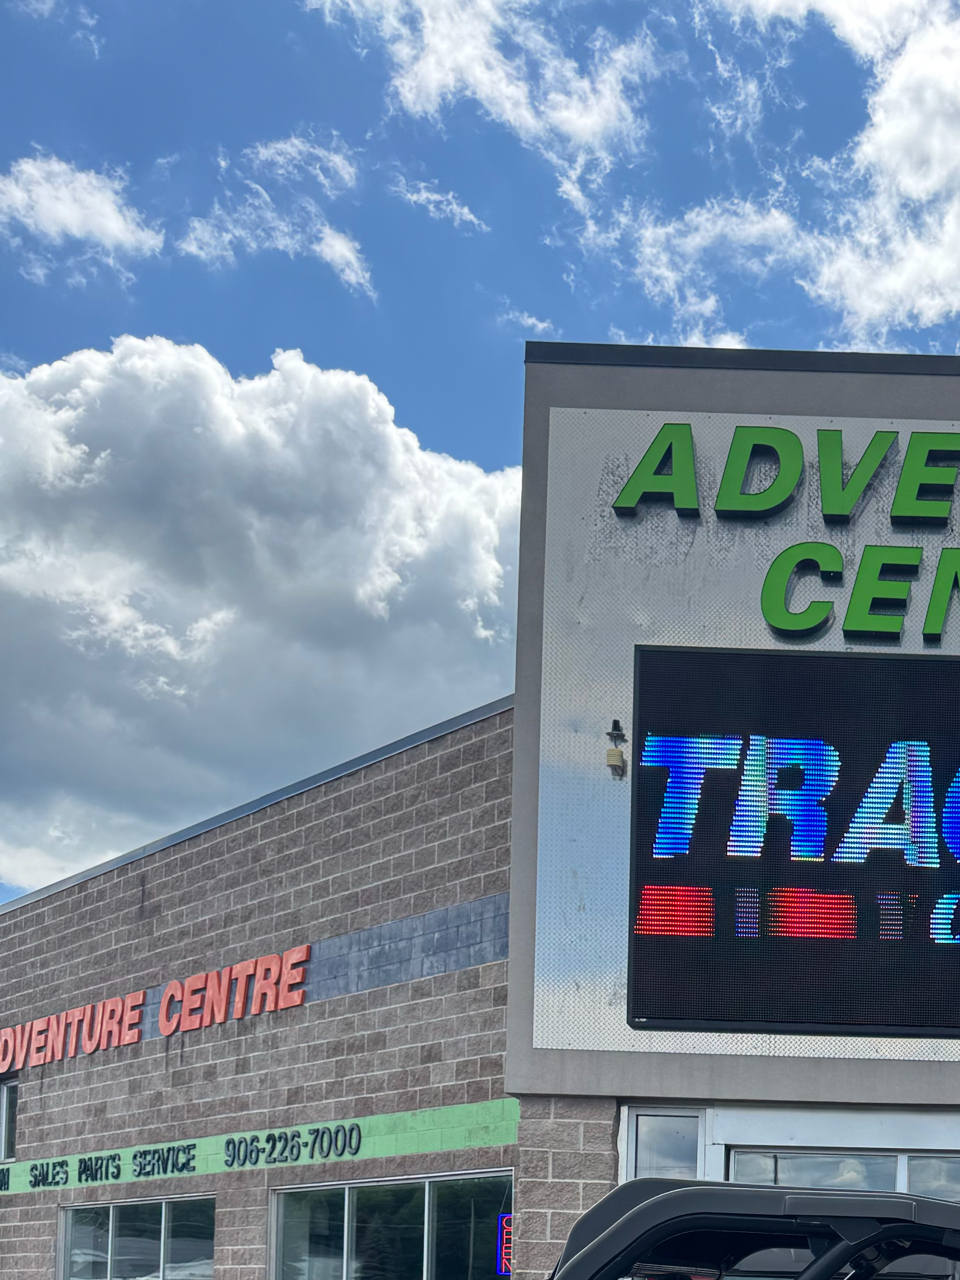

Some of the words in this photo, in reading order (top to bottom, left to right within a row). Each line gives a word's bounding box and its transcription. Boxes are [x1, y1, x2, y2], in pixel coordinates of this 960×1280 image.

[0, 990, 146, 1073] DVENTURE
[158, 944, 311, 1036] CENTRE
[29, 1160, 69, 1188] SALES
[78, 1154, 121, 1183] PARTS
[132, 1144, 197, 1178] SERVICE
[224, 1123, 362, 1168] 906-226-7000
